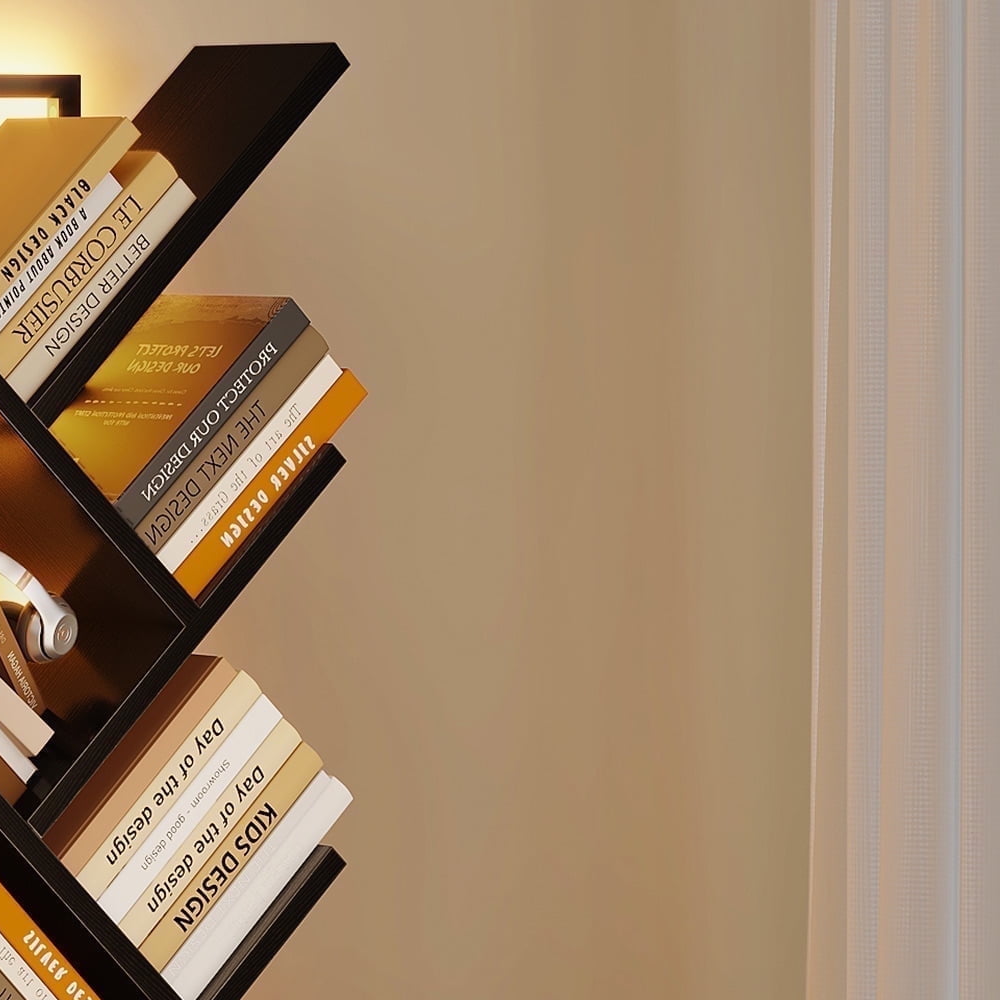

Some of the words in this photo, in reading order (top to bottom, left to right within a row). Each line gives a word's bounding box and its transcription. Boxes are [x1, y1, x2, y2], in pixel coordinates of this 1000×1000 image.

[48, 178, 91, 226] BLACK
[78, 207, 87, 220] A
[112, 194, 143, 230] LE
[54, 217, 79, 250] BOOK
[0, 226, 49, 282] DESIGN
[26, 245, 54, 283] ABOUT
[97, 233, 150, 294] BETTER
[11, 226, 117, 344] CORBUSIER
[44, 291, 100, 357] DESIGN
[194, 717, 224, 755] Day
[179, 754, 194, 780] of
[190, 759, 230, 808] Showroom
[235, 765, 264, 803] Day
[152, 775, 179, 806] the
[165, 813, 186, 841] good
[219, 802, 234, 828] of
[234, 802, 278, 856] KIDS
[106, 806, 152, 865] design
[140, 839, 167, 870] design
[193, 822, 219, 854] the
[147, 854, 193, 912] design
[173, 850, 239, 933] DESIGN
